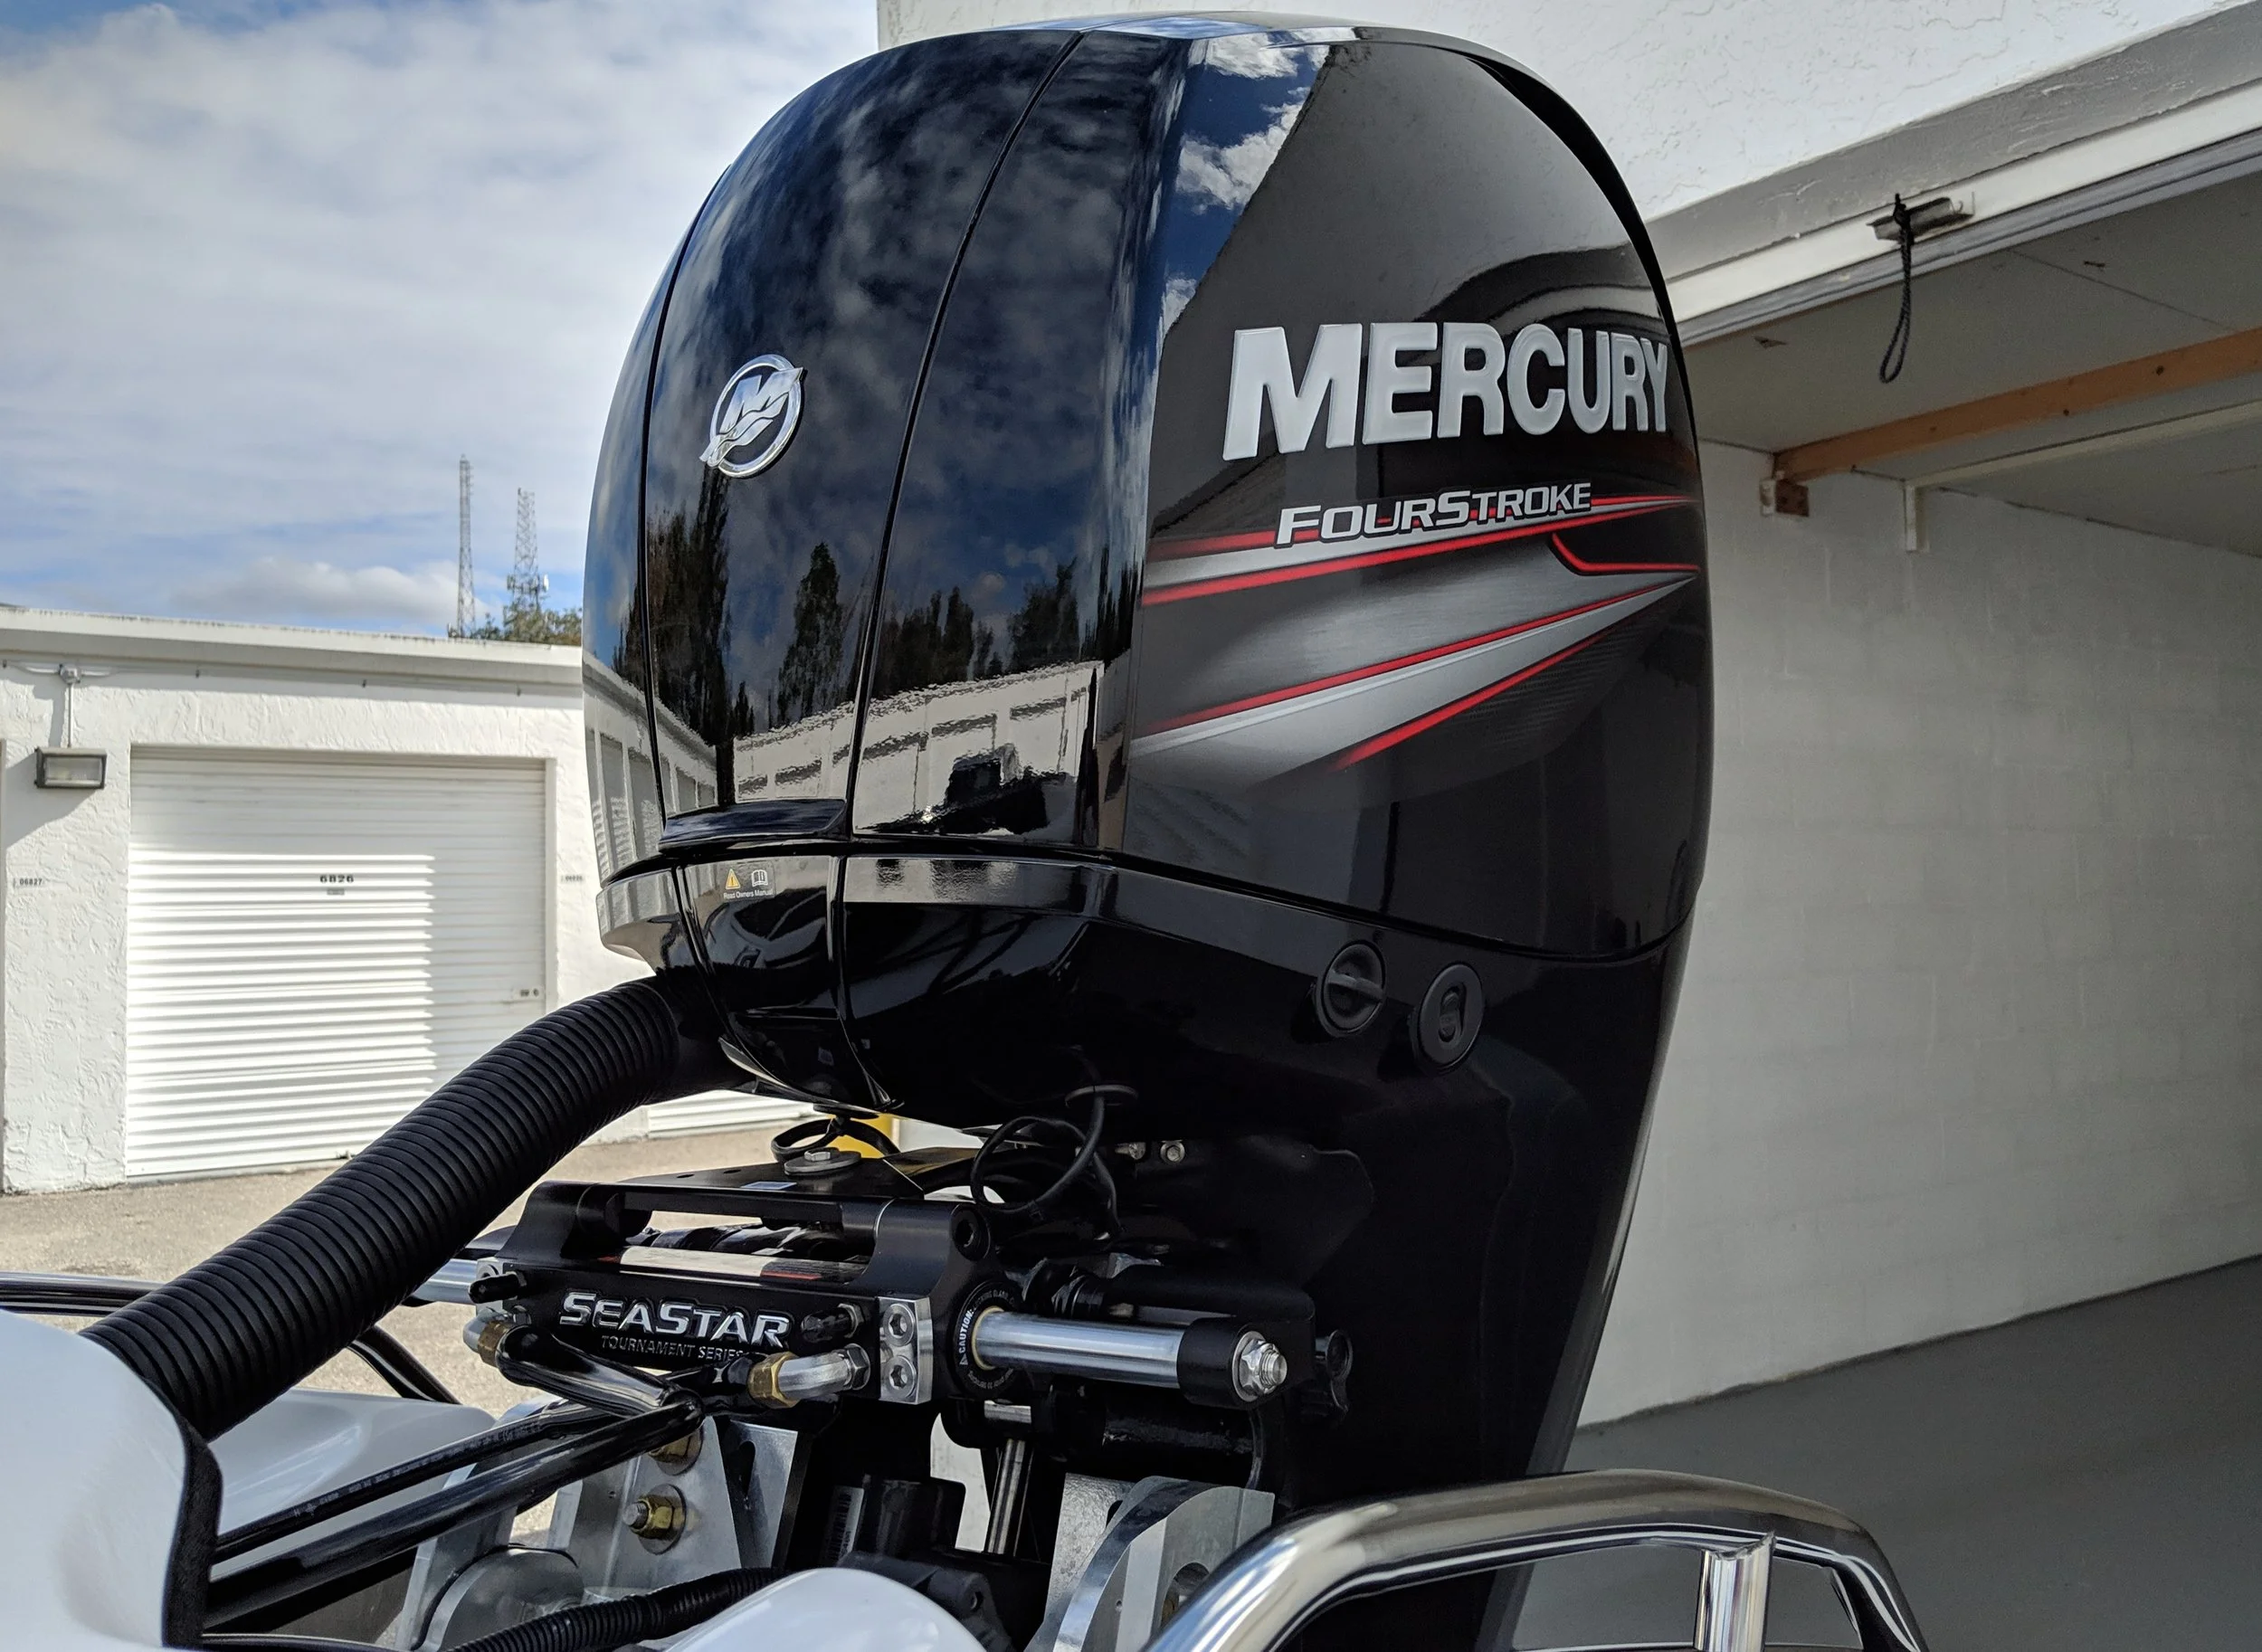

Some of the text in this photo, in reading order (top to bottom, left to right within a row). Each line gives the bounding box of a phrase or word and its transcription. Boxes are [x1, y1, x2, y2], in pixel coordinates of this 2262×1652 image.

[1222, 322, 1668, 461] MERCURY
[319, 873, 355, 883] 6826
[601, 1334, 696, 1357] TOURNAMENT
